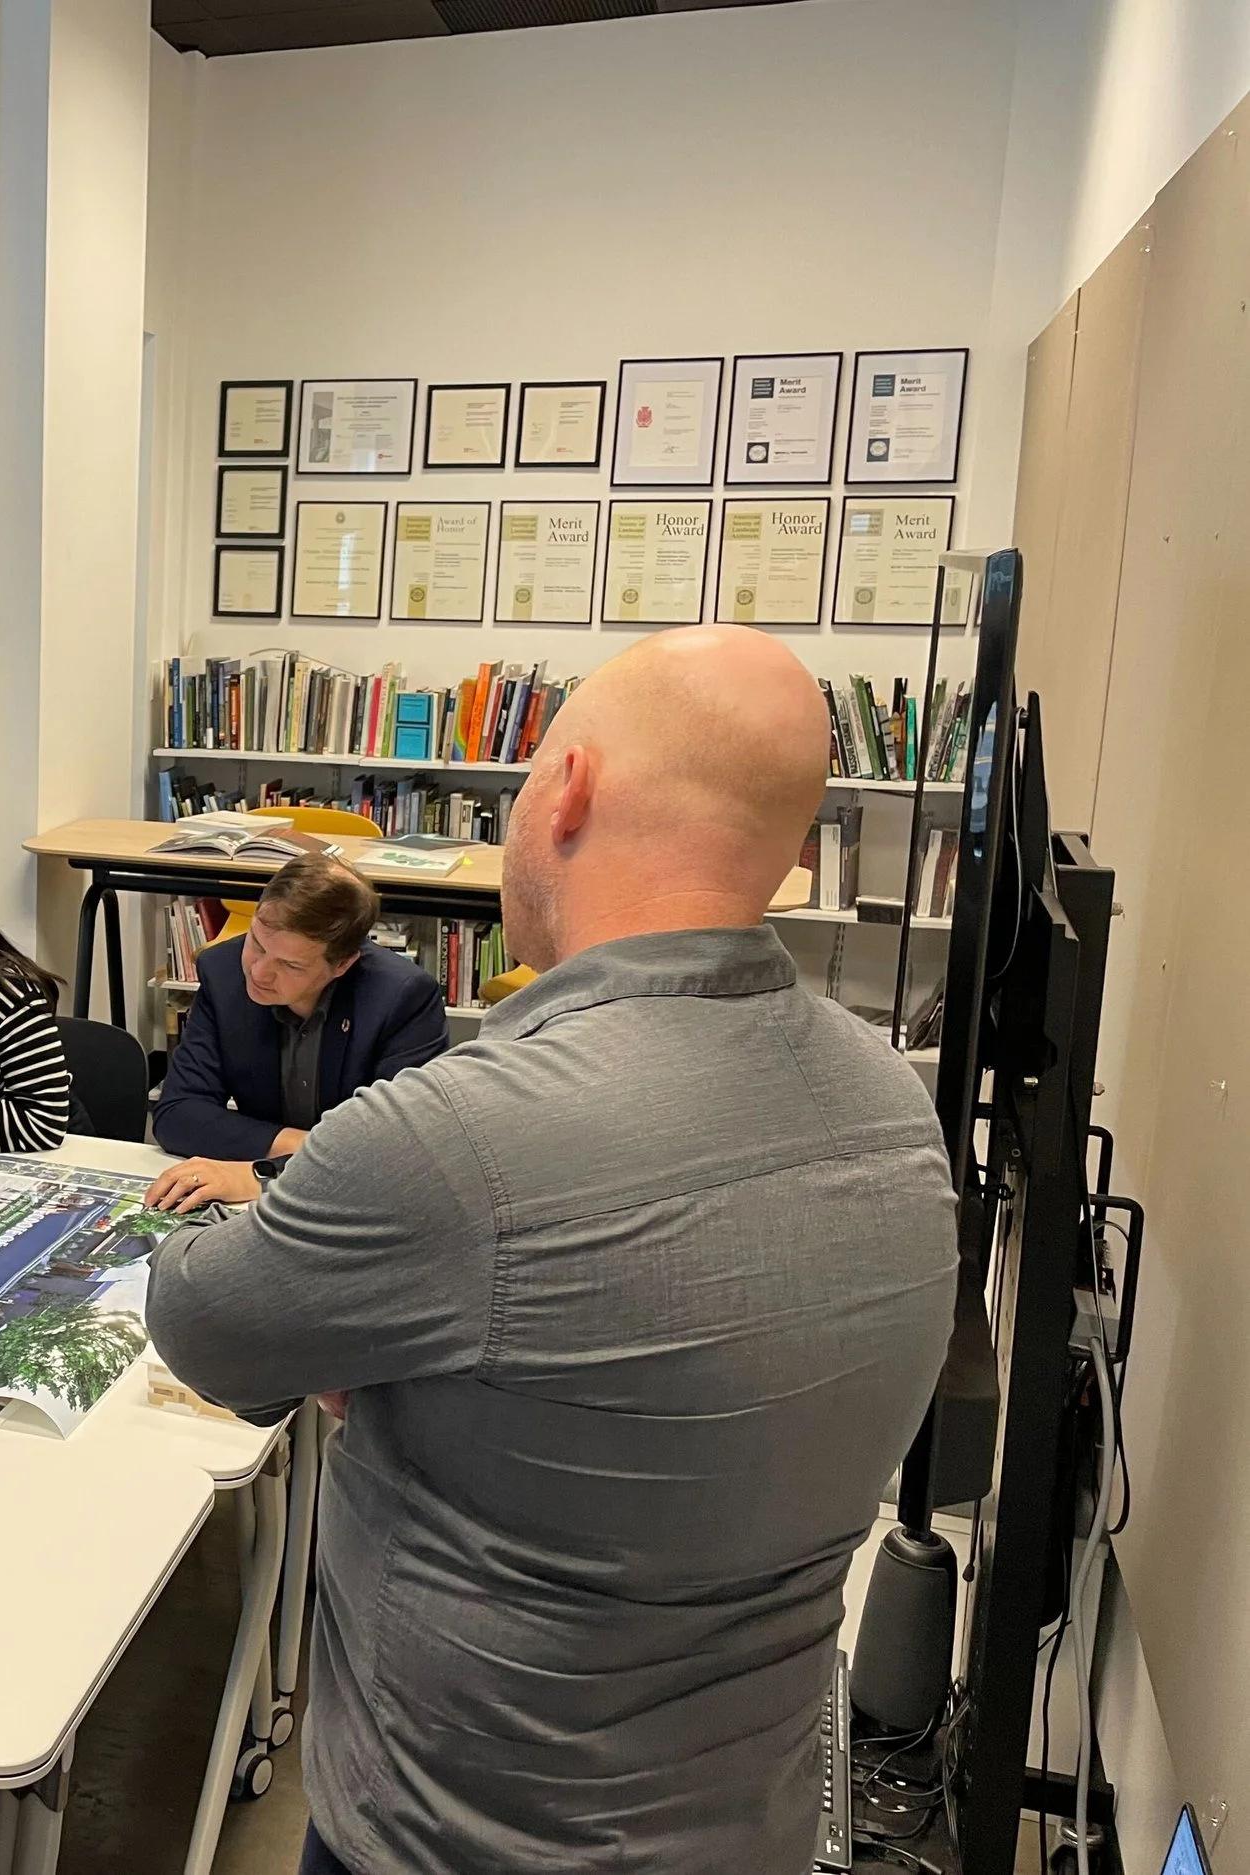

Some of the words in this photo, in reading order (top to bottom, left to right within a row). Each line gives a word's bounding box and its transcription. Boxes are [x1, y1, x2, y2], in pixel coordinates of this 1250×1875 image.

[436, 516, 464, 526] Award
[467, 516, 478, 525] of
[549, 517, 582, 529] Merit
[656, 513, 699, 525] Honor
[772, 512, 816, 524] Honor
[895, 514, 930, 525] Merit
[436, 522, 465, 533] Honor
[662, 524, 704, 536] Award
[778, 522, 822, 534] Award
[894, 528, 936, 539] Award
[548, 531, 589, 542] Award
[440, 958, 448, 985] STATION
